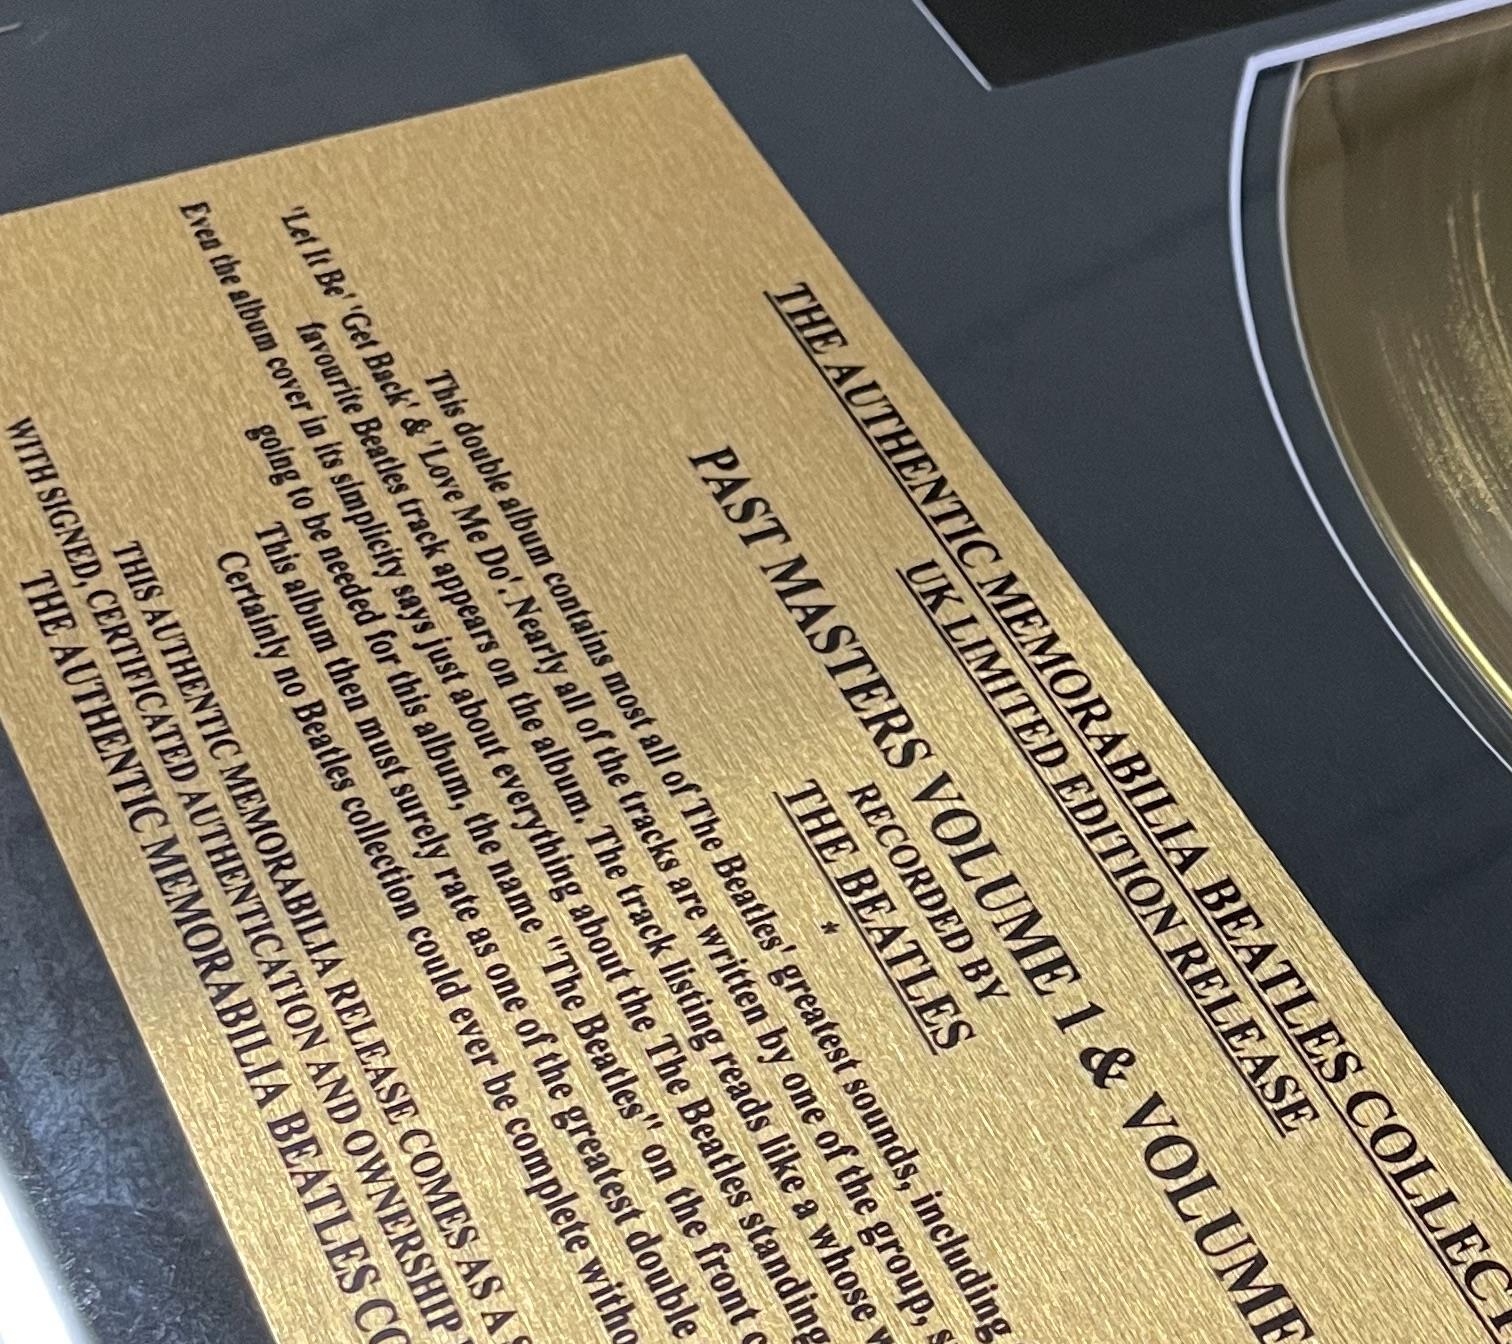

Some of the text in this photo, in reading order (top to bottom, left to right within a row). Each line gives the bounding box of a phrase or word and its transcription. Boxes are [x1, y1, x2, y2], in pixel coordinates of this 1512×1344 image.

[110, 539, 165, 603] THIS
[686, 444, 794, 549] PAST
[19, 568, 79, 639] THE
[139, 608, 244, 762] AUTHENTIC
[502, 593, 570, 676] Nearly
[758, 552, 937, 770] MASTERS
[774, 280, 850, 356] THE
[823, 363, 1005, 570] AUTHENTIC
[975, 569, 1211, 878] MEMORABILIA
[1190, 873, 1368, 1085] BEATLES
[47, 645, 172, 835] AUTHENTIC
[226, 288, 280, 354] album
[264, 355, 315, 412] cover
[328, 472, 408, 579] simplicity
[409, 635, 470, 686] just
[447, 687, 512, 761] about
[490, 762, 584, 905] everything
[567, 903, 636, 984] about
[643, 1031, 692, 1097] The
[675, 1094, 754, 1209] Beatles
[294, 320, 365, 416] favourite
[348, 415, 411, 497] Beatles
[395, 496, 452, 561] track
[428, 561, 501, 655] appears
[529, 735, 594, 826] album.
[583, 823, 629, 881] The
[615, 882, 679, 961] track
[657, 956, 726, 1054] listing
[708, 1050, 775, 1134] reads
[755, 1131, 807, 1195] like
[807, 1221, 878, 1323] whose
[451, 420, 514, 494] double
[495, 496, 556, 569] album
[541, 571, 615, 669] contains
[599, 669, 659, 732] most
[679, 796, 725, 853] The
[709, 851, 798, 954] Beatles'
[765, 963, 864, 1076] greatest
[840, 1077, 921, 1193] sounds,
[616, 789, 682, 874] tracks
[6, 415, 61, 486] WITH
[35, 485, 104, 590] SIGNED,
[84, 588, 201, 784] CERTIFICATED
[175, 790, 332, 1053] AUTHENTICATION
[304, 1060, 363, 1126] AND
[341, 1128, 465, 1333] OWNERSHIP
[215, 550, 292, 660] Certainly
[289, 697, 357, 793] Beatles
[339, 795, 422, 922] collection
[405, 925, 474, 1003] could
[447, 1006, 500, 1067] ever
[503, 1116, 592, 1255] complete
[217, 760, 346, 980] MEMORABILIA
[242, 423, 302, 488] going
[316, 544, 389, 628] needed
[410, 720, 474, 812] album,
[485, 857, 545, 935] name
[570, 1010, 666, 1132] Beatles"
[692, 1240, 762, 1328] front
[253, 519, 302, 576] This
[280, 577, 340, 655] album
[323, 655, 371, 714] then
[353, 715, 413, 782] must
[388, 782, 452, 860] surely
[432, 865, 481, 924] rate
[548, 1104, 646, 1228] greatest
[624, 1229, 701, 1341] double
[782, 777, 978, 1051] THE BEATLES
[845, 780, 1012, 1003] RECORDED BY
[905, 557, 1322, 1134] UK LIMITED EDITION RELEASE
[910, 769, 1083, 999] VOLUME
[138, 832, 293, 1111] MEMORABILIA
[322, 977, 421, 1127] RELEASE
[695, 922, 770, 1027] written
[1051, 999, 1107, 1034] 1
[780, 1071, 827, 1126] one
[1077, 1045, 1138, 1091] &
[265, 1108, 382, 1295] BEATLES
[397, 1127, 481, 1251] COMES
[454, 1258, 506, 1302] AS
[833, 1163, 880, 1217] the
[855, 1219, 936, 1328] group,
[479, 1309, 519, 1337] A
